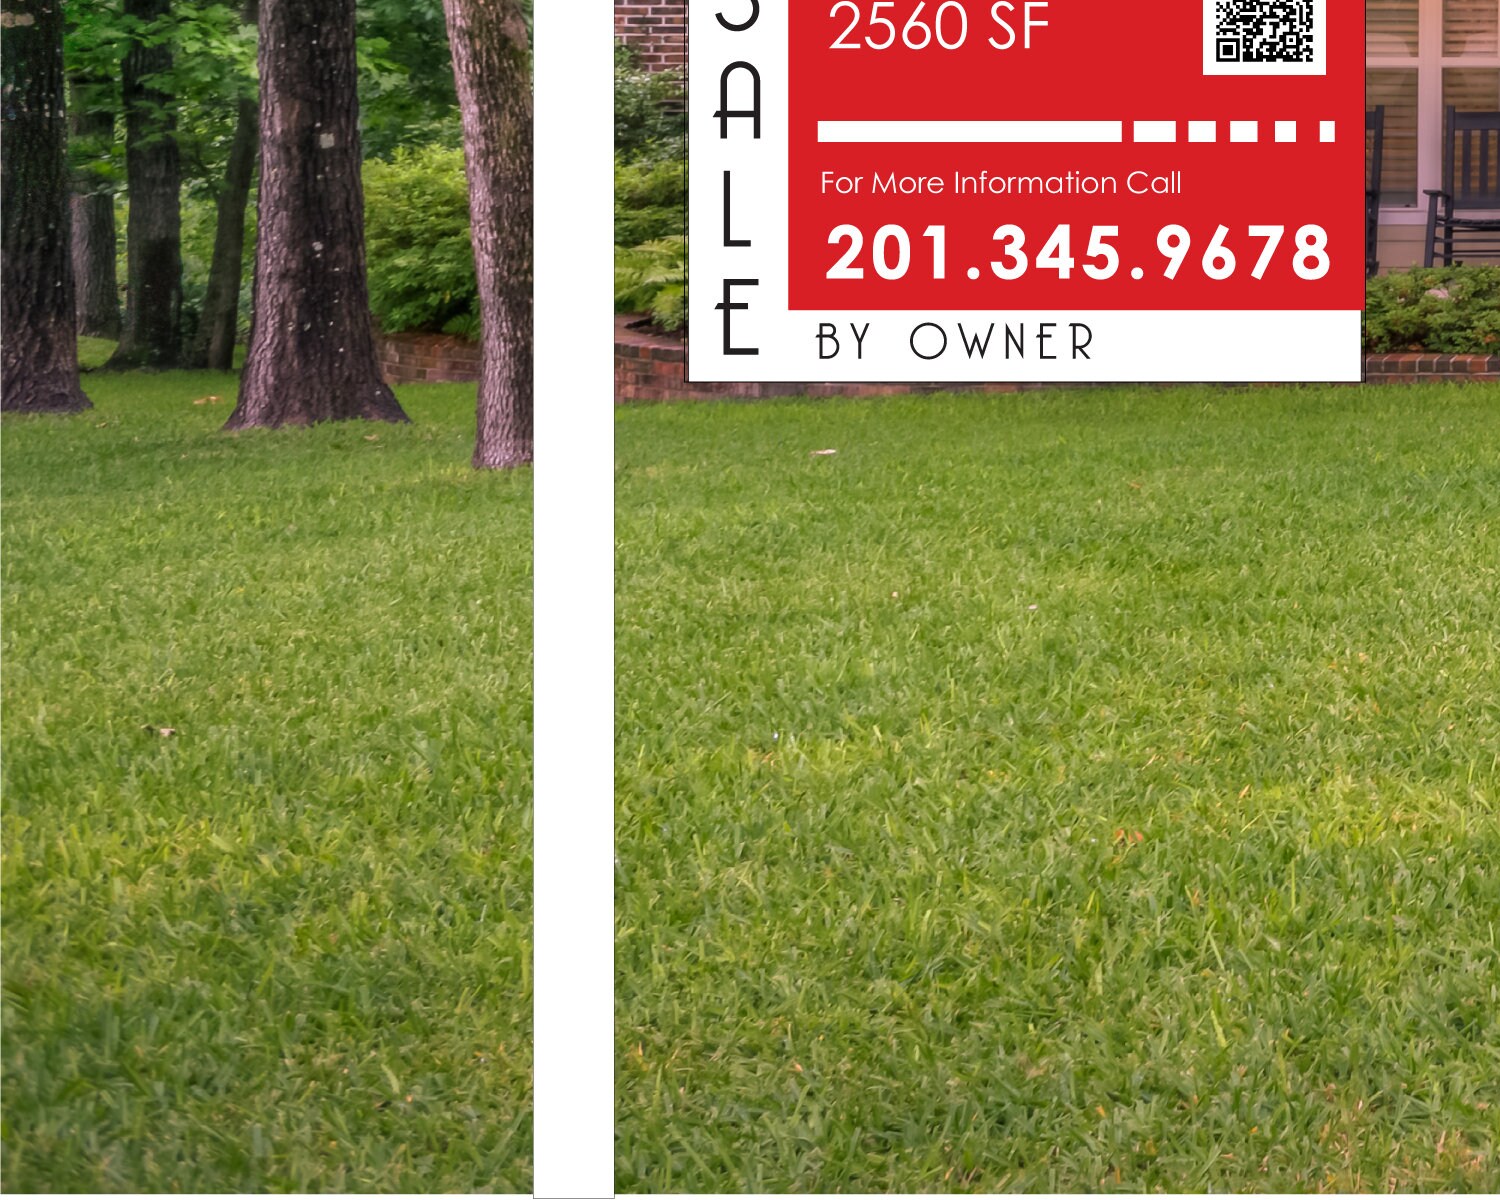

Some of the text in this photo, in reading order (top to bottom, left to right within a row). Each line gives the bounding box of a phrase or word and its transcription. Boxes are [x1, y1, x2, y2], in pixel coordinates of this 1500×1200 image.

[829, 0, 1049, 50] 2560 SF
[821, 170, 1181, 195] For More Information Call
[825, 223, 1331, 281] 201.345.9678
[815, 322, 1093, 360] BY OWNER
